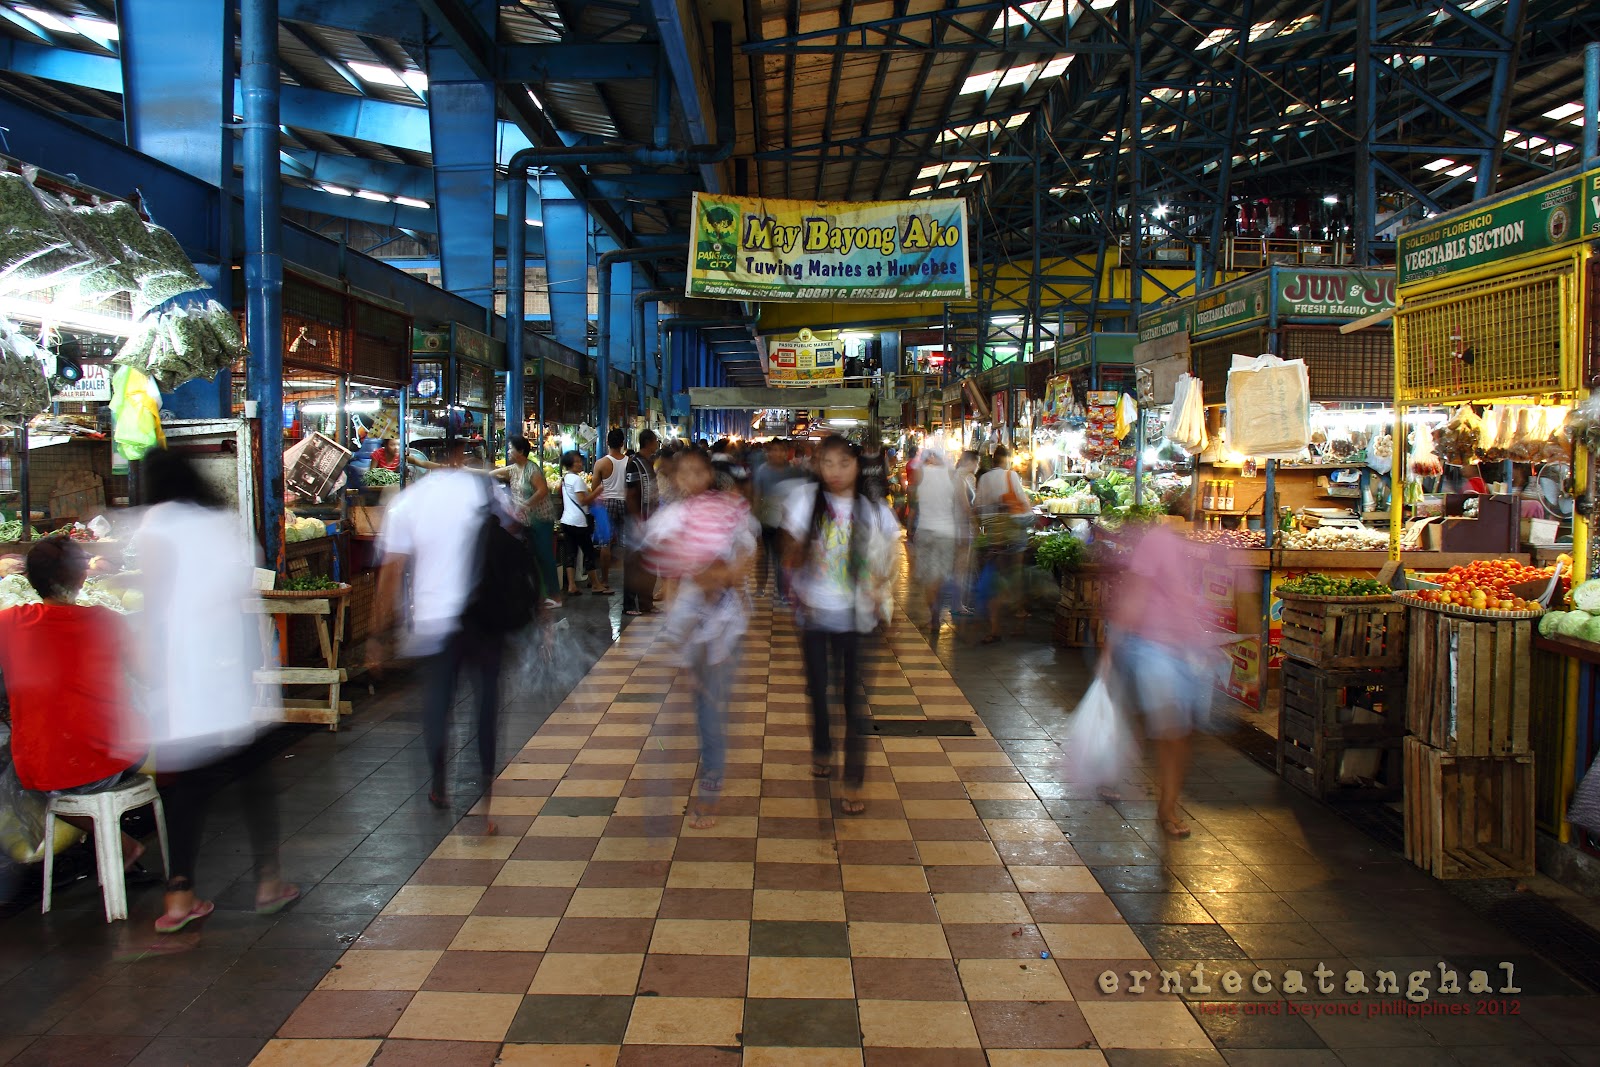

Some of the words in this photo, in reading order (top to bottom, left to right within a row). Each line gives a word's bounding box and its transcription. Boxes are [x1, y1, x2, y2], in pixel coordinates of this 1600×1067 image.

[744, 215, 801, 253] May
[805, 217, 896, 256] Bayong
[901, 214, 959, 248] Ako
[1405, 230, 1439, 250] SOLEDAD
[1442, 214, 1493, 239] FLORENCIO
[1405, 238, 1467, 272] VEGETABLE
[1469, 220, 1524, 255] SECTION
[710, 260, 732, 269] CITY
[746, 257, 803, 279] Tuwing
[809, 259, 862, 277] Martes
[867, 261, 882, 276] at
[888, 258, 957, 276] Huwebes
[796, 288, 837, 299] BOBBY
[837, 288, 847, 299] C.
[850, 288, 897, 299] EUSEBIO
[931, 288, 962, 297] Council
[1283, 274, 1348, 304] JUN
[1350, 284, 1362, 297] &
[1294, 304, 1327, 314] FRESH
[1329, 305, 1368, 315] BAGUIO
[82, 380, 105, 391] DEALER
